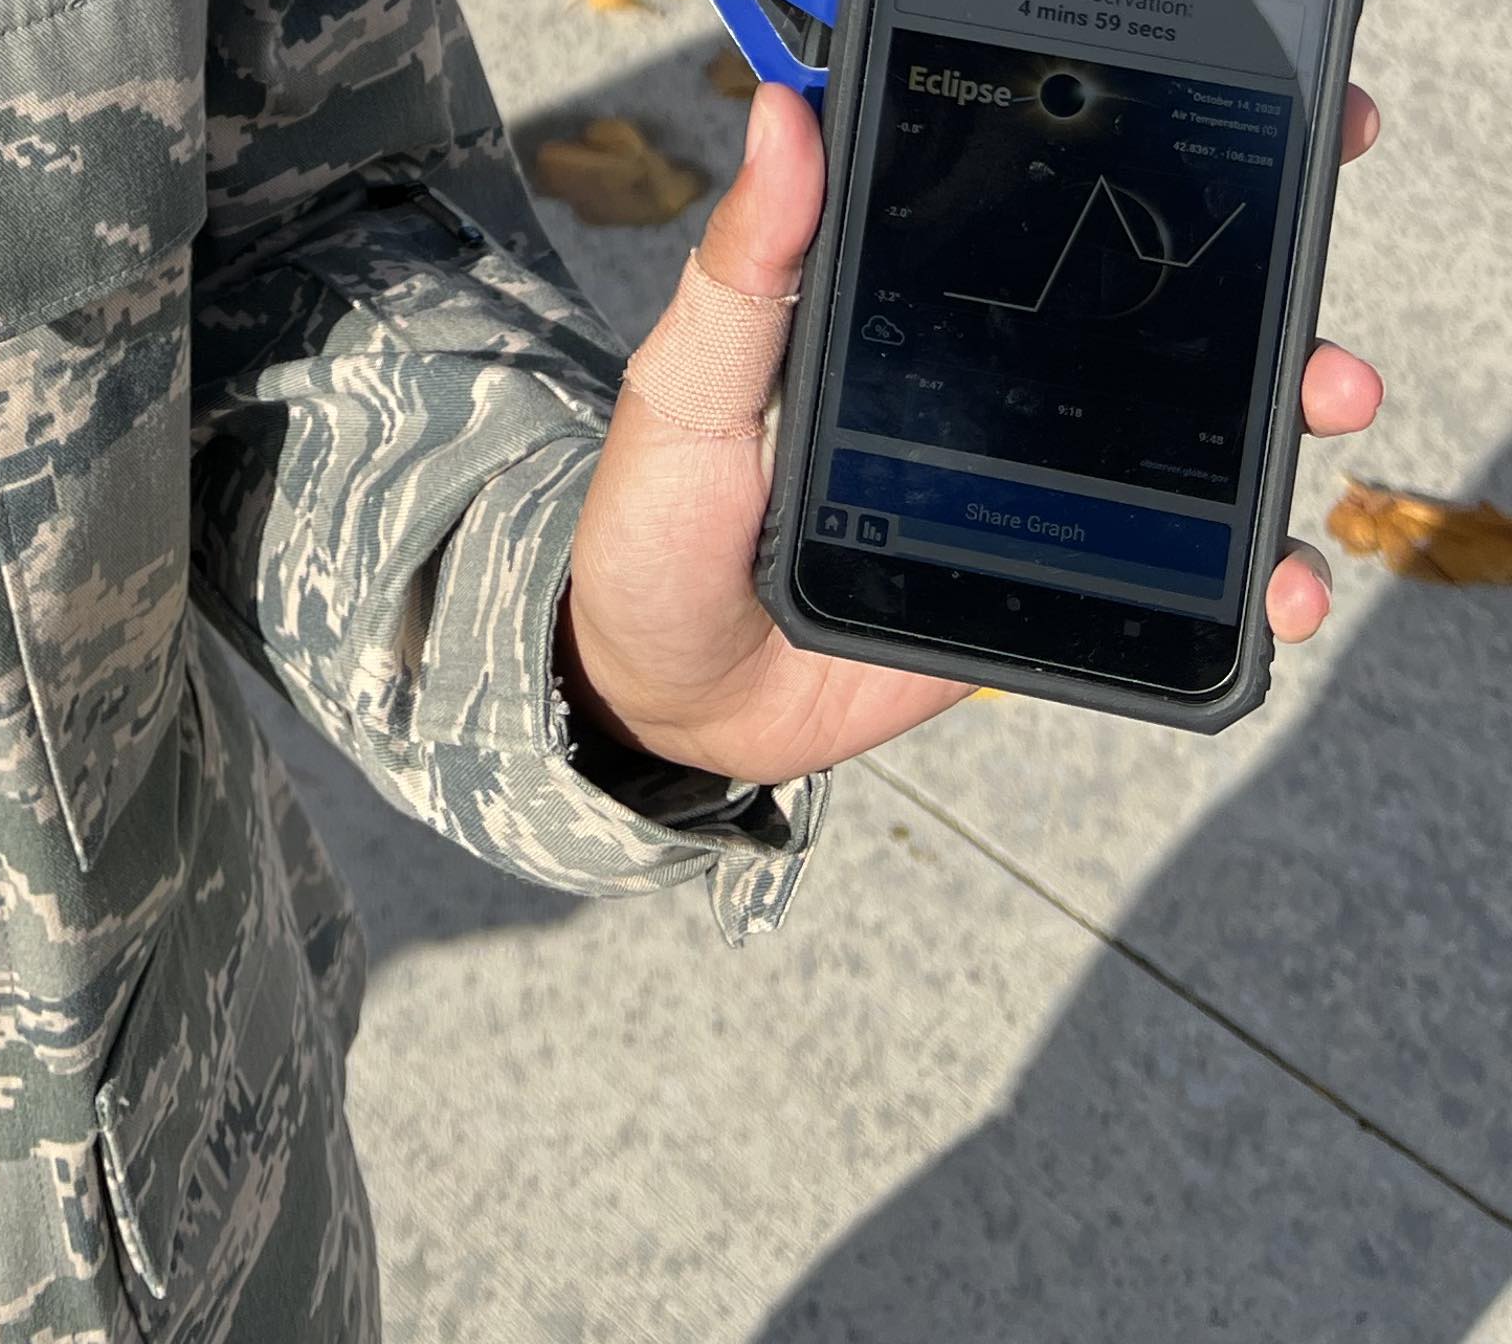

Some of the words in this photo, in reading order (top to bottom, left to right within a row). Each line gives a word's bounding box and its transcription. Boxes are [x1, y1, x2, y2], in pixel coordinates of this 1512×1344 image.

[1018, 0, 1031, 17] 4
[1036, 4, 1088, 27] mins
[1094, 12, 1122, 31] 59
[1127, 21, 1177, 42] secs
[908, 64, 1013, 108] Eclipse
[1193, 93, 1234, 108] October
[1171, 109, 1188, 120] Air
[1190, 112, 1260, 133] Temperatures
[1261, 125, 1278, 139] (C)
[1057, 403, 1083, 418] 9:18
[965, 502, 1022, 529] Share
[1026, 515, 1086, 543] Graph
